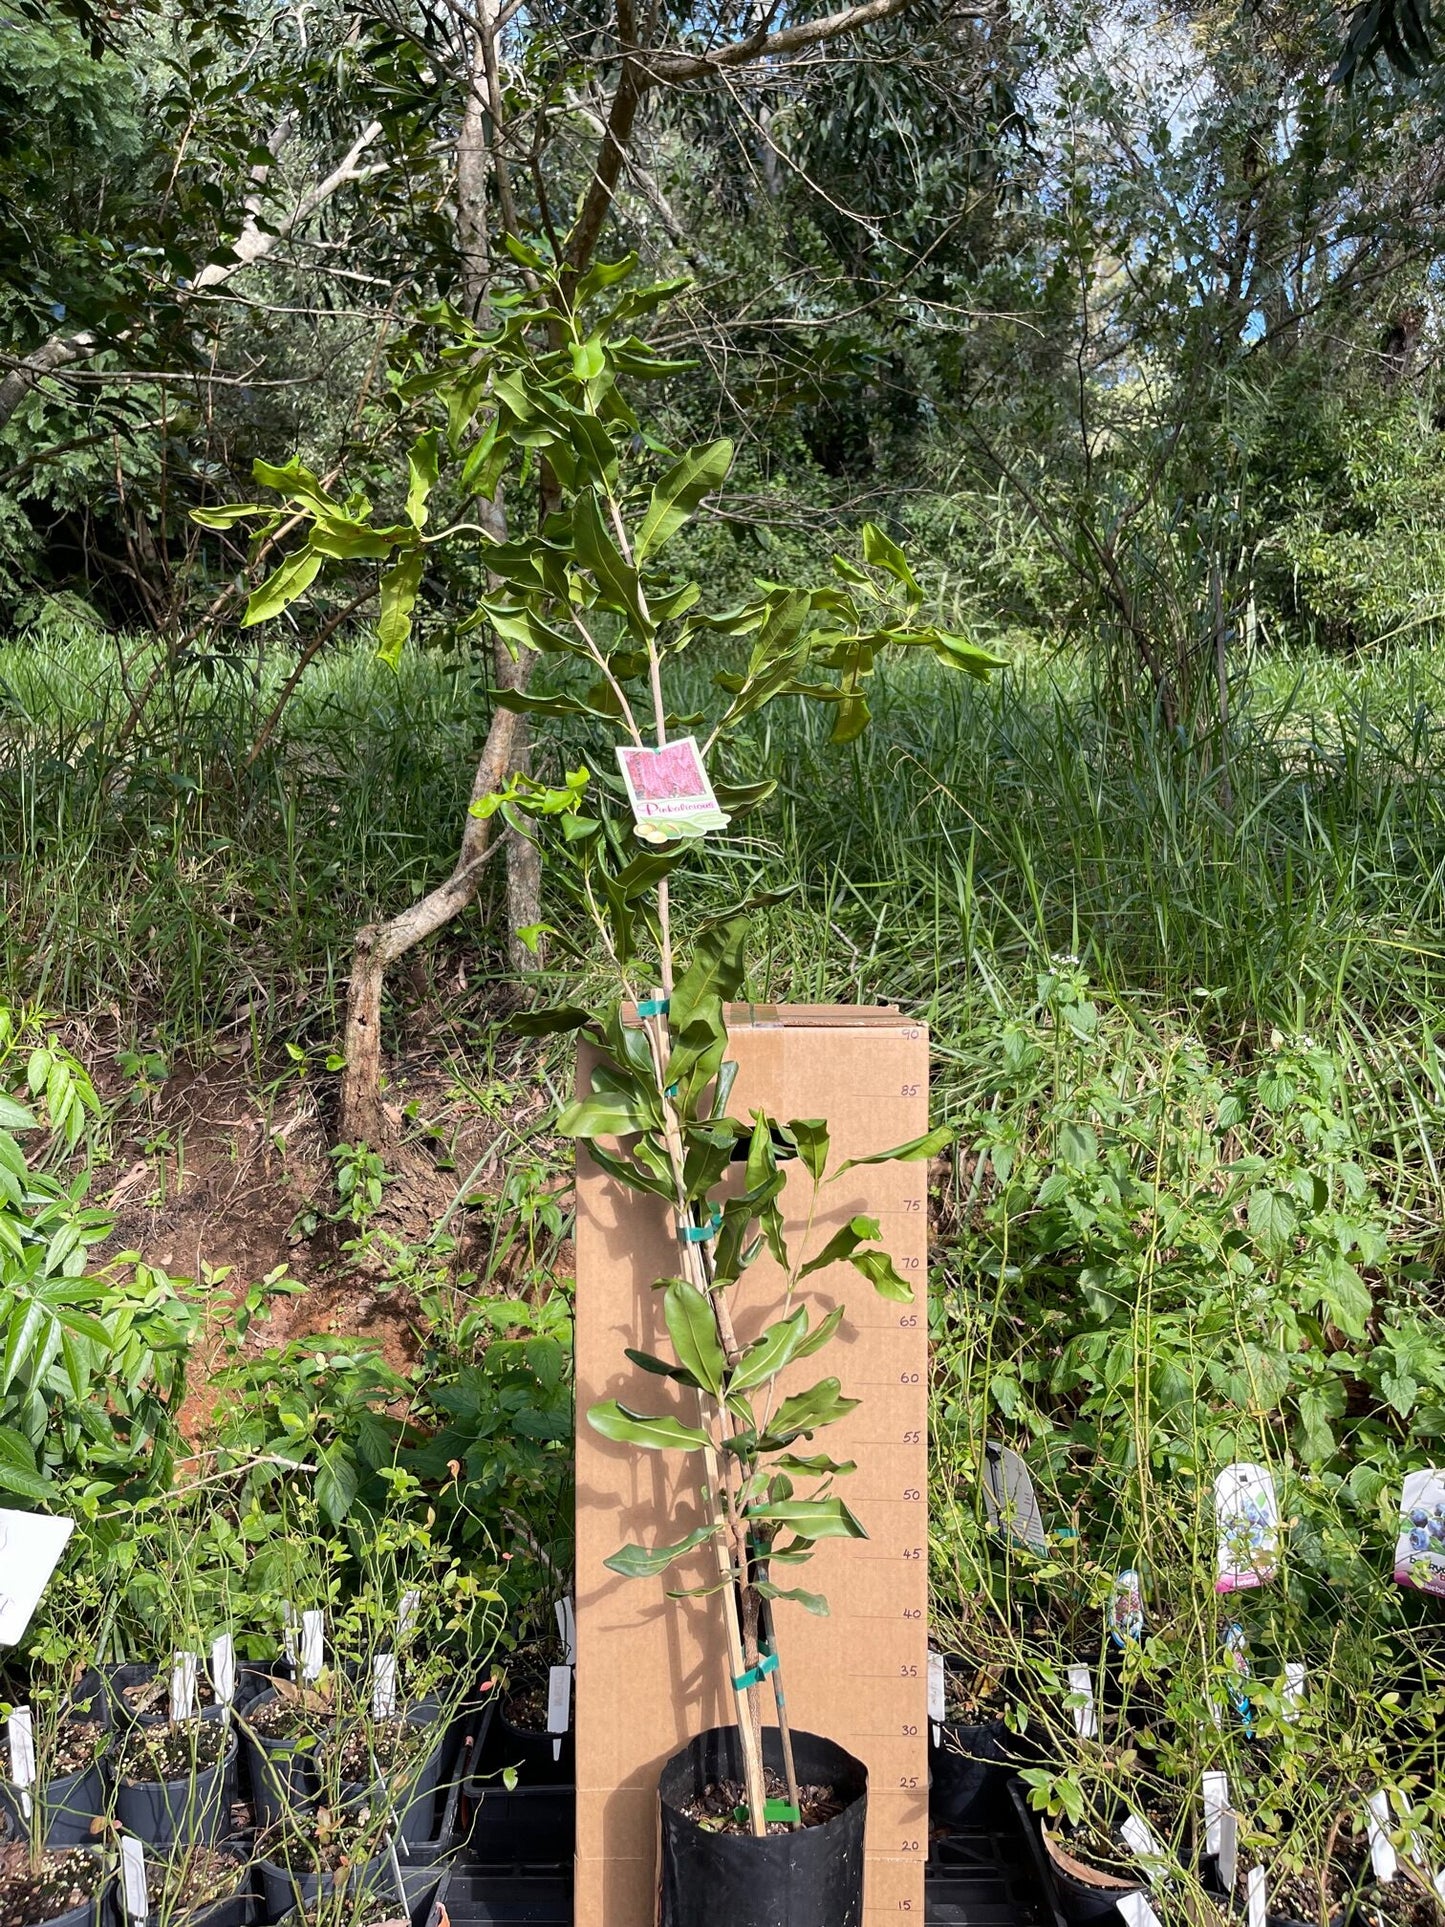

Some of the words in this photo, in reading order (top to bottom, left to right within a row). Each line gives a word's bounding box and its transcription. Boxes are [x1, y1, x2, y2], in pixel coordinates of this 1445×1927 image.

[902, 1030, 919, 1041] 90
[901, 1084, 920, 1097] 85
[903, 1200, 921, 1211] 75
[902, 1258, 919, 1269] 70
[900, 1315, 917, 1327] 65
[900, 1373, 919, 1384] 60
[903, 1431, 920, 1443] 55
[903, 1489, 920, 1501] 50
[903, 1549, 921, 1560] 45
[903, 1609, 921, 1619] 40
[900, 1665, 917, 1677] 35
[902, 1725, 918, 1736] 30
[900, 1777, 918, 1789] 25
[902, 1841, 919, 1851] 20
[898, 1900, 911, 1910] 15
